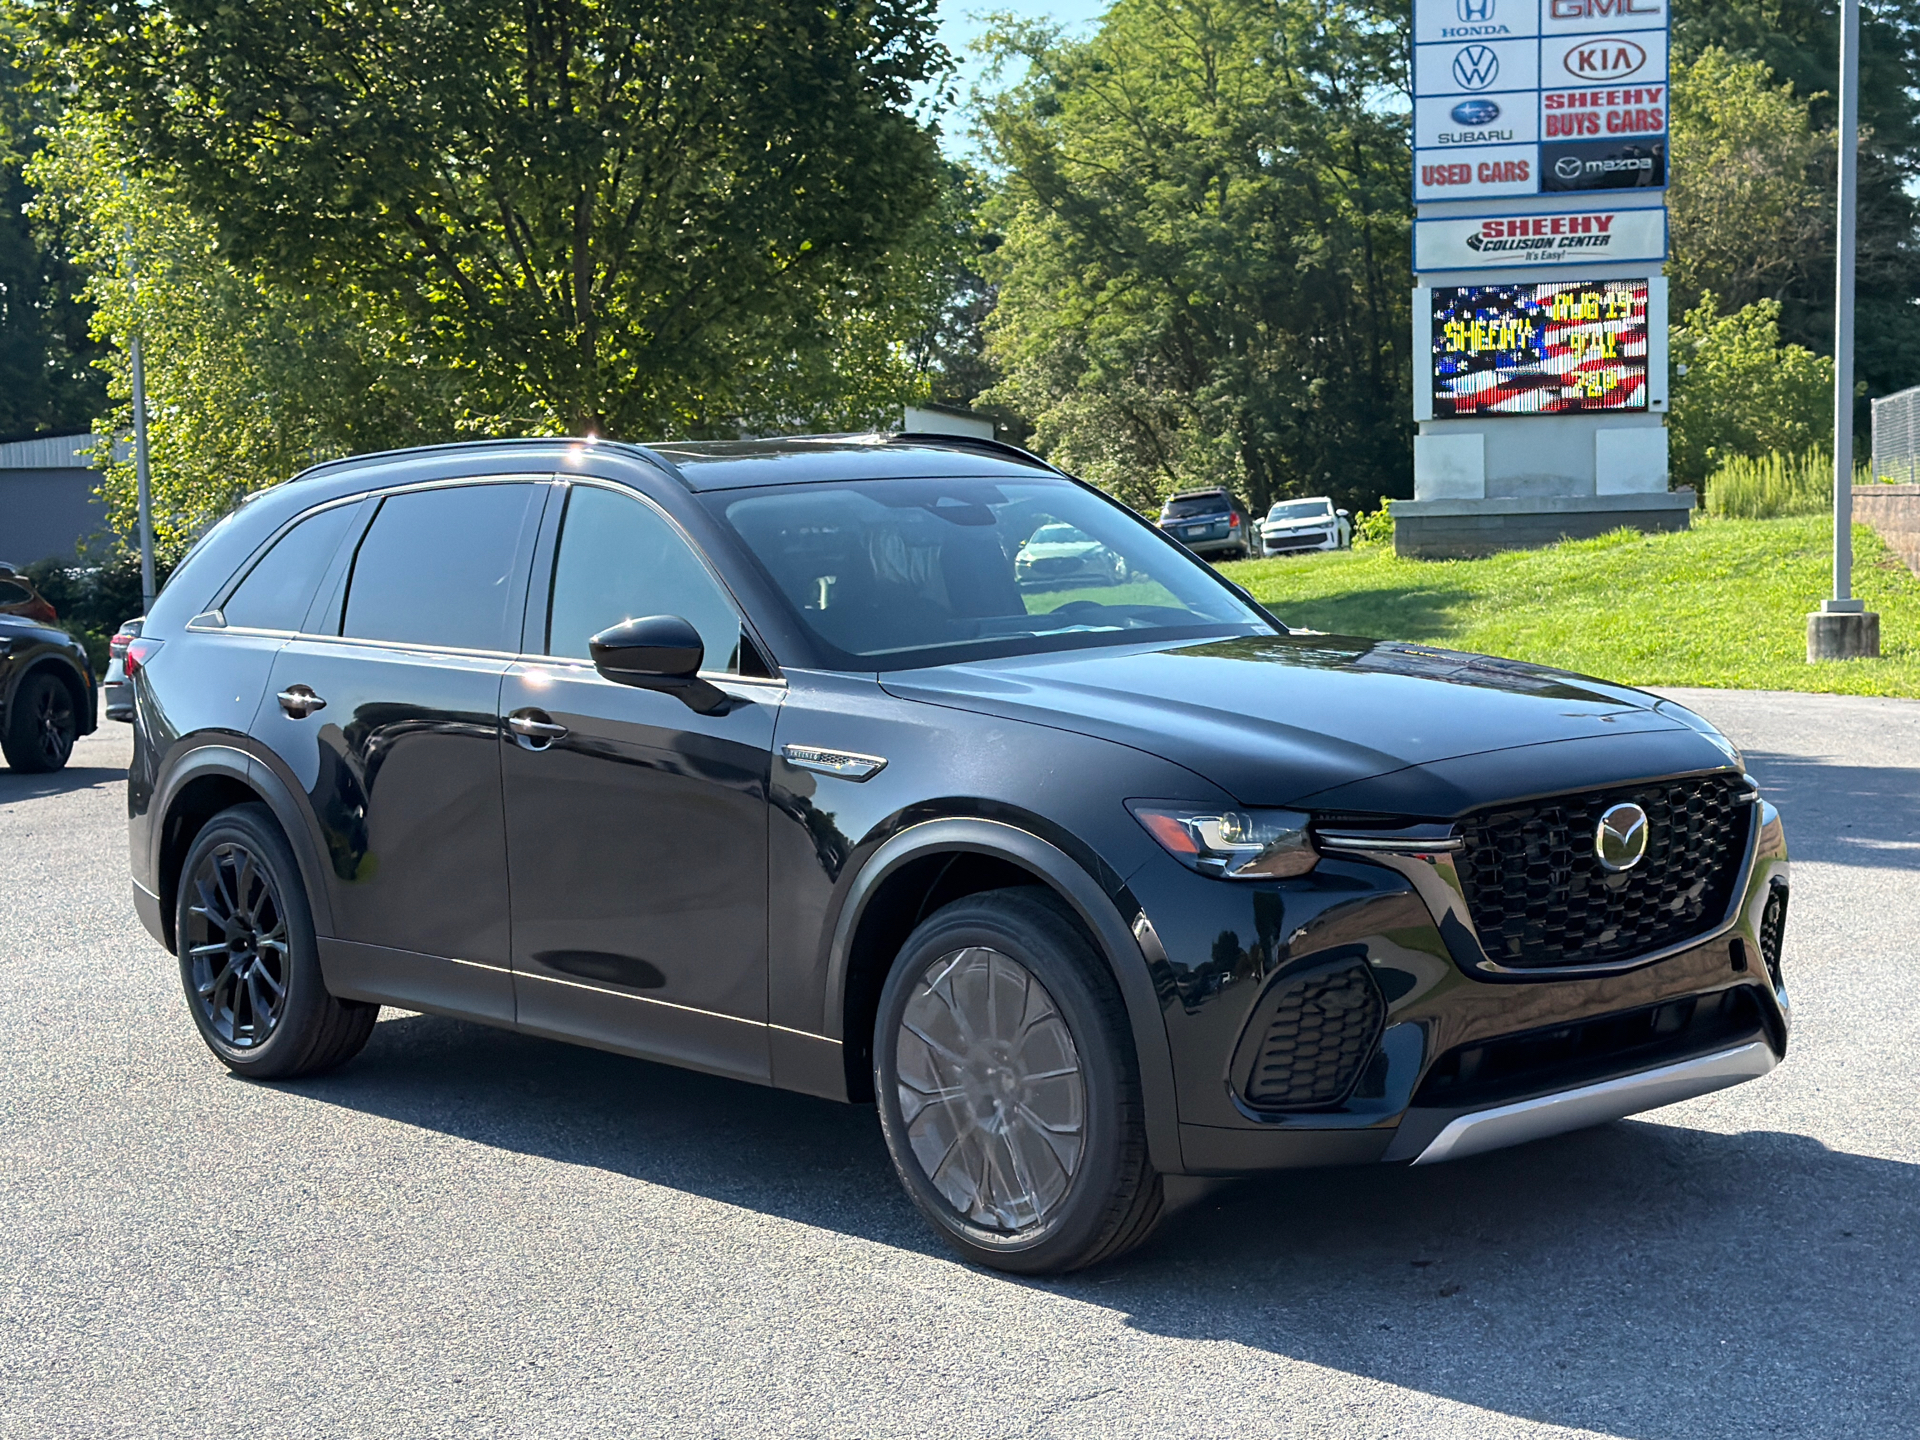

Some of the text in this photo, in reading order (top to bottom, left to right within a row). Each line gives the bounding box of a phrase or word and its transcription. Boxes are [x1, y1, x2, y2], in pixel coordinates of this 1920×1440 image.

[1441, 24, 1511, 38] HONDA
[1578, 48, 1632, 71] KIA
[1545, 88, 1663, 110] SHEEHY
[1546, 108, 1663, 137] BUYS CARS
[1438, 129, 1513, 144] SUBARU
[1422, 160, 1529, 186] USED CARS
[1585, 158, 1652, 173] mazda
[1481, 215, 1614, 238] SHEEHY
[1482, 234, 1611, 252] COLLISION CENTER
[1525, 250, 1566, 261] It's Easy!
[1443, 318, 1532, 352] SHEEHY
